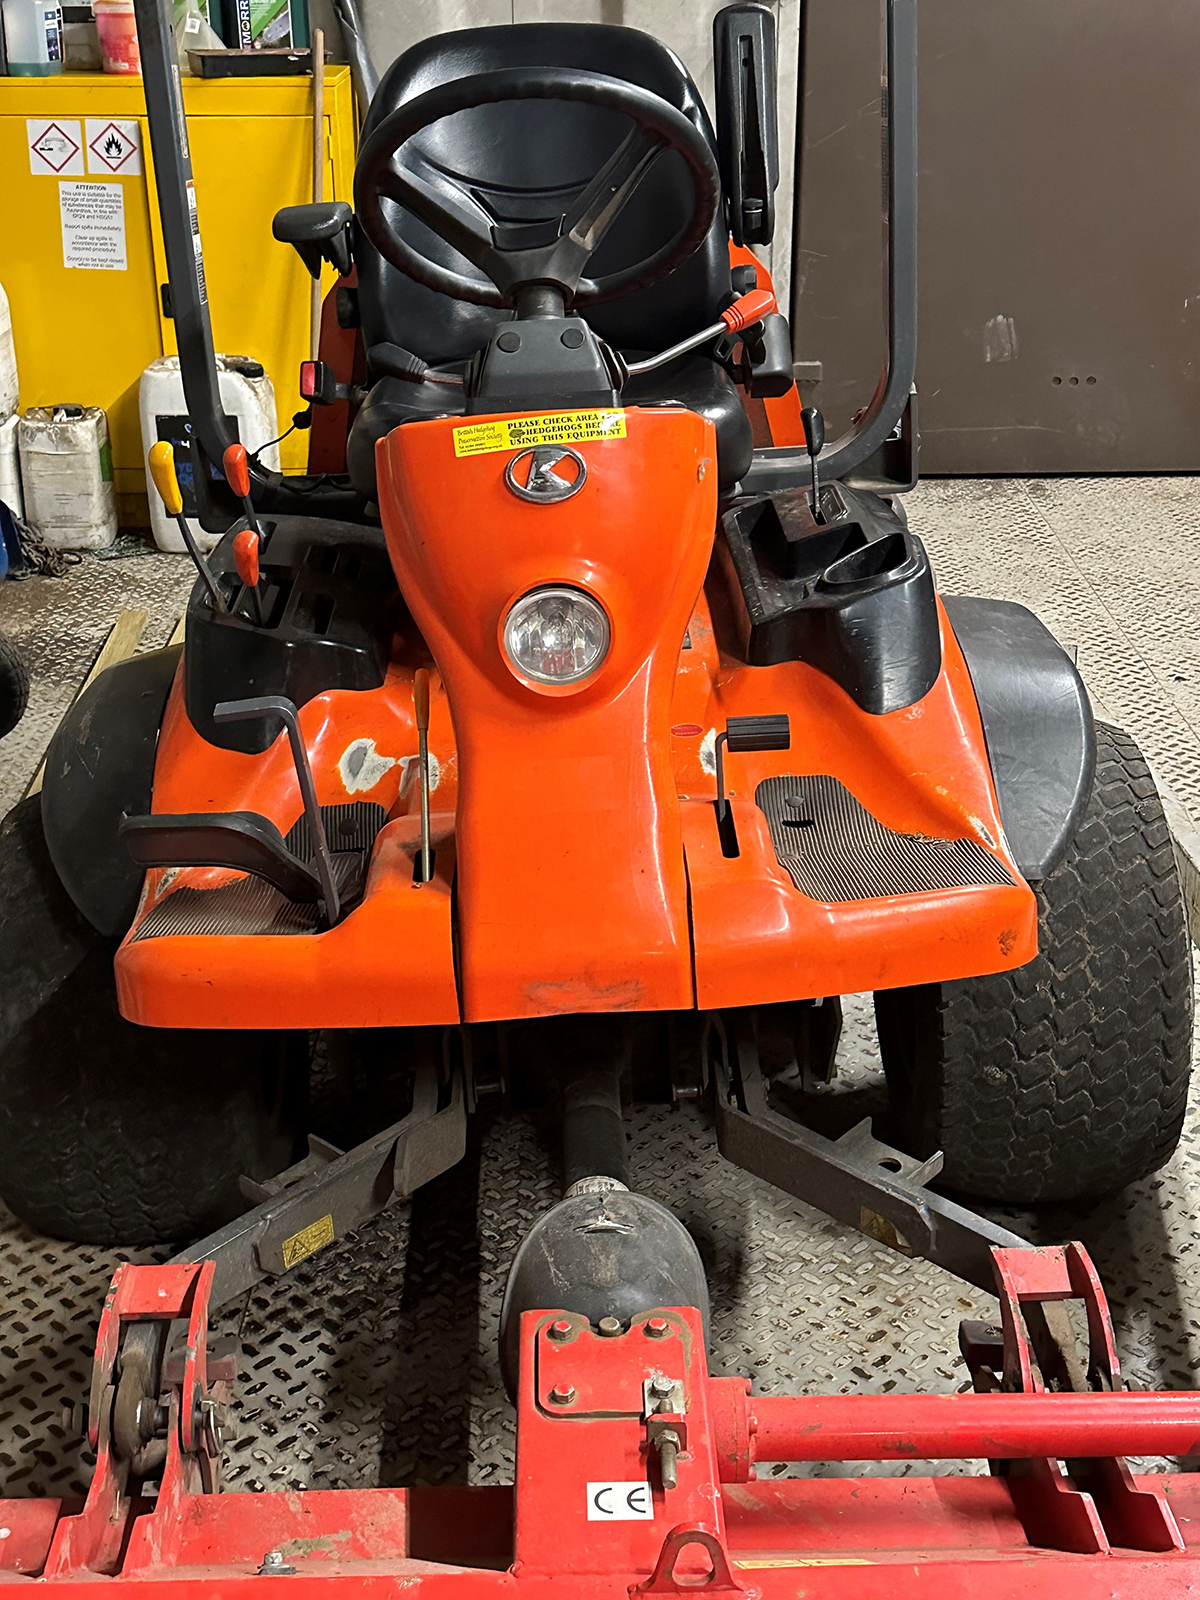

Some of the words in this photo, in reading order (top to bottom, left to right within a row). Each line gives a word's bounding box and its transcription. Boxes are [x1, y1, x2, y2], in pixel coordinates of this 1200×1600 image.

[508, 419, 540, 429] PLEASE
[543, 415, 573, 425] CHECK
[576, 414, 598, 422] AREA
[526, 423, 582, 435] HEDGEHOGS
[510, 436, 538, 446] USING
[542, 433, 563, 441] THIS
